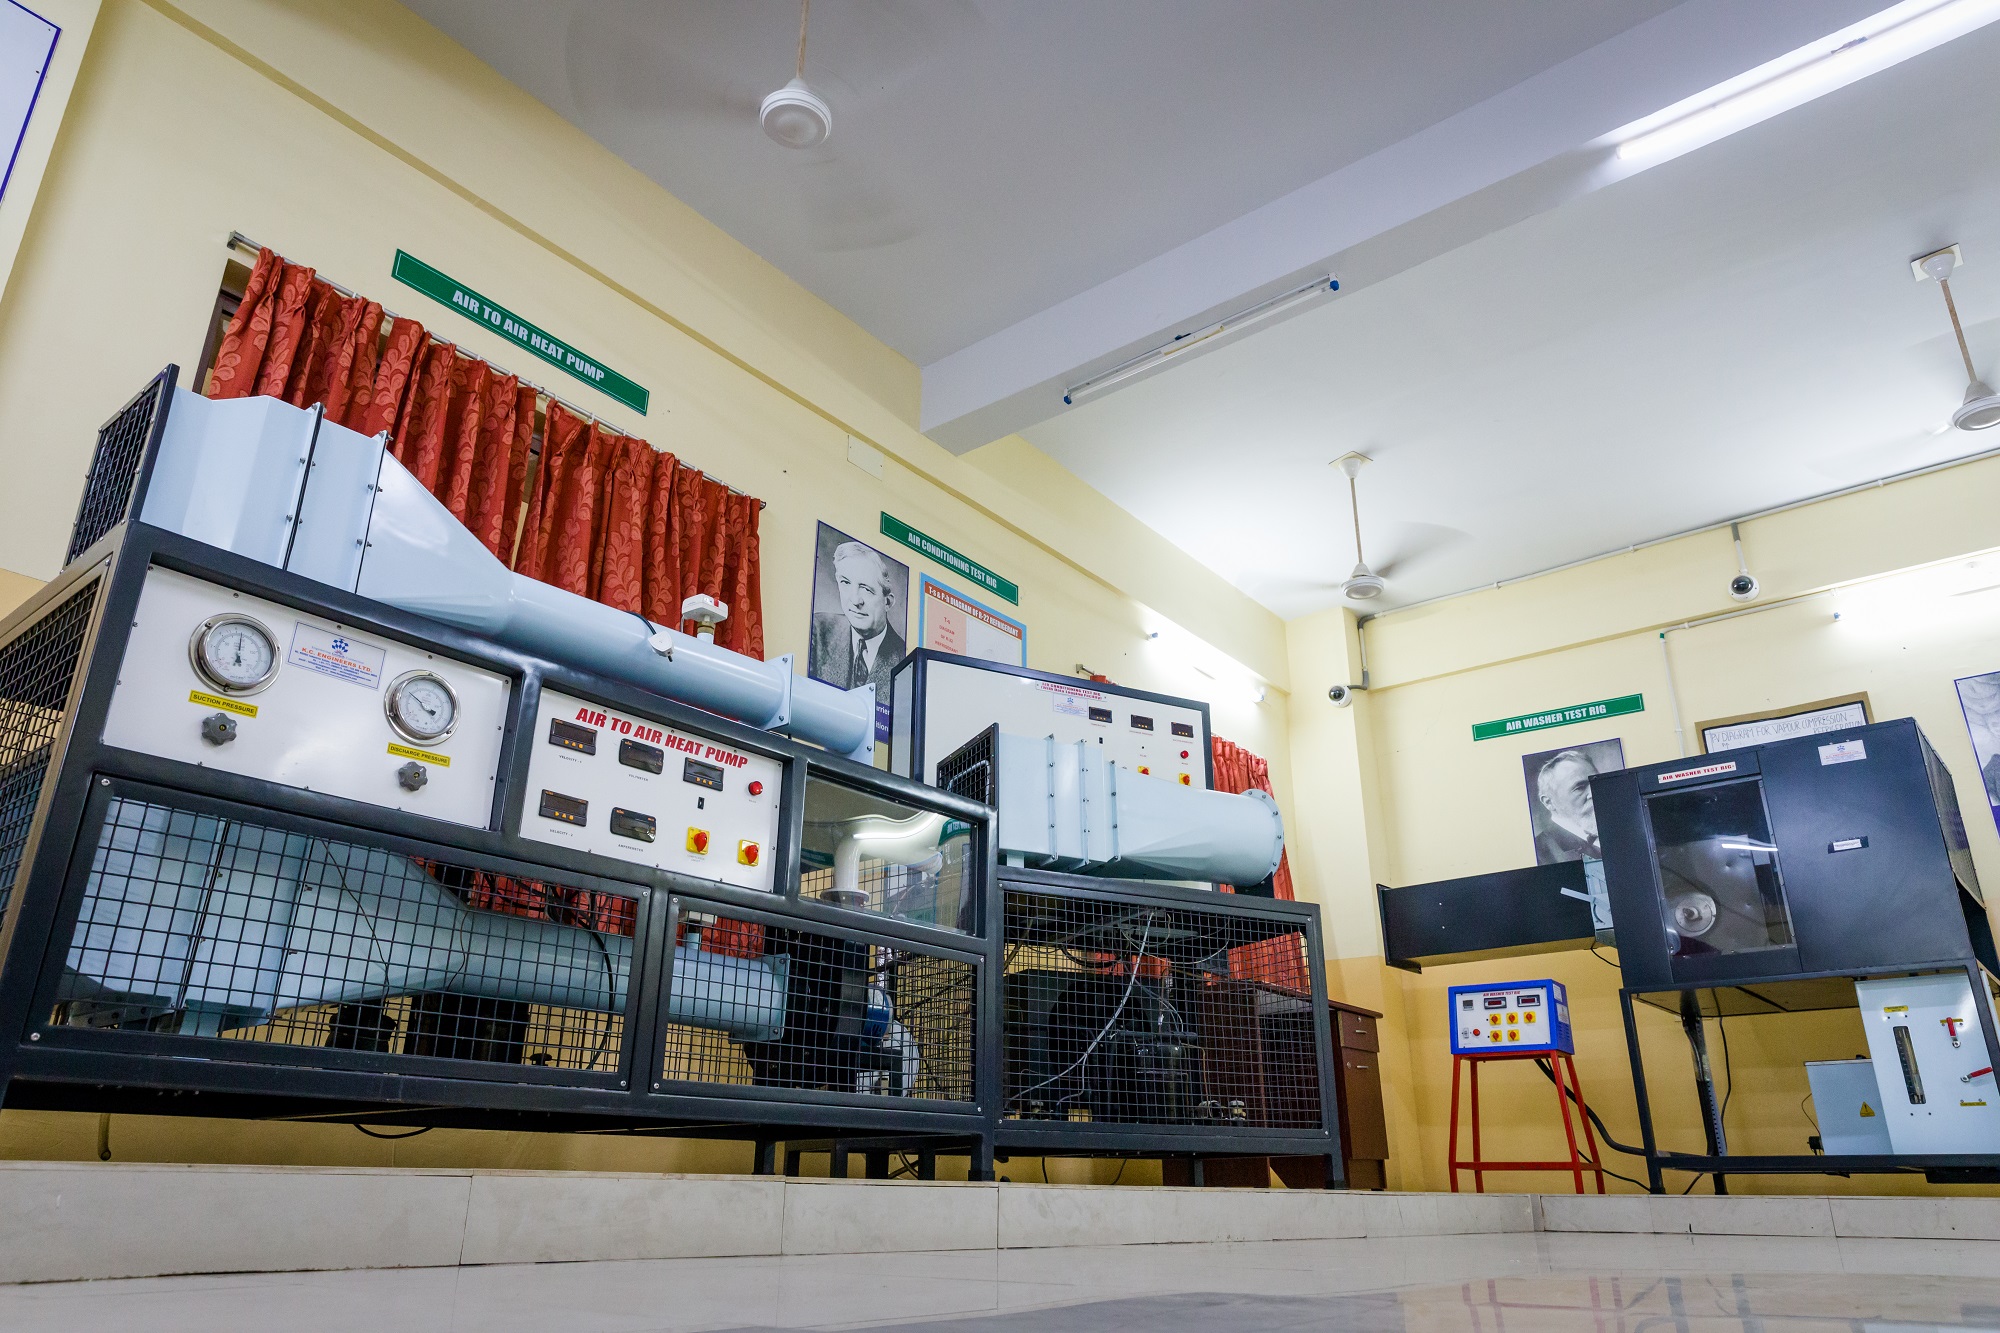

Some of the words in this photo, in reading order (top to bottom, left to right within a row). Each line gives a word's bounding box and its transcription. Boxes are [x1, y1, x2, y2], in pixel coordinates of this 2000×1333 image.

[452, 289, 480, 315] AIR
[482, 305, 501, 326] TO
[502, 318, 529, 341] AIR
[530, 332, 565, 360] HEAT
[566, 352, 605, 382] PUMP
[908, 532, 920, 547] AIR
[921, 539, 969, 573] CONDITIONING
[970, 566, 986, 582] TEST
[986, 575, 997, 588] RIG
[950, 597, 972, 615] DIAGRAM
[972, 608, 979, 618] OF
[979, 611, 989, 623] R-22
[989, 616, 1019, 637] REFRIGERANT
[301, 647, 316, 656] K.C.
[317, 651, 357, 668] ENGINEERS
[358, 664, 372, 673] LTD.
[193, 694, 221, 705] SUCTION
[221, 701, 255, 714] PRESSURE
[876, 705, 889, 715] arrier
[1506, 721, 1522, 731] AIR
[1523, 713, 1563, 728] WASHER
[1564, 708, 1587, 720] TEST
[1588, 704, 1607, 716] RIG
[575, 707, 607, 728] AIR
[610, 717, 632, 735] TO
[633, 725, 663, 744] AIR
[664, 733, 704, 756] HEAT
[704, 746, 749, 769] PUMP
[1721, 728, 1755, 742] DIAGRAM
[1756, 725, 1772, 736] FOR
[1772, 720, 1801, 734] VAPOUR
[1801, 712, 1848, 729] COMPRESSION
[390, 745, 420, 758] DISCHARGE
[420, 753, 448, 764] PRESSURE
[1674, 770, 1702, 779] WASHER
